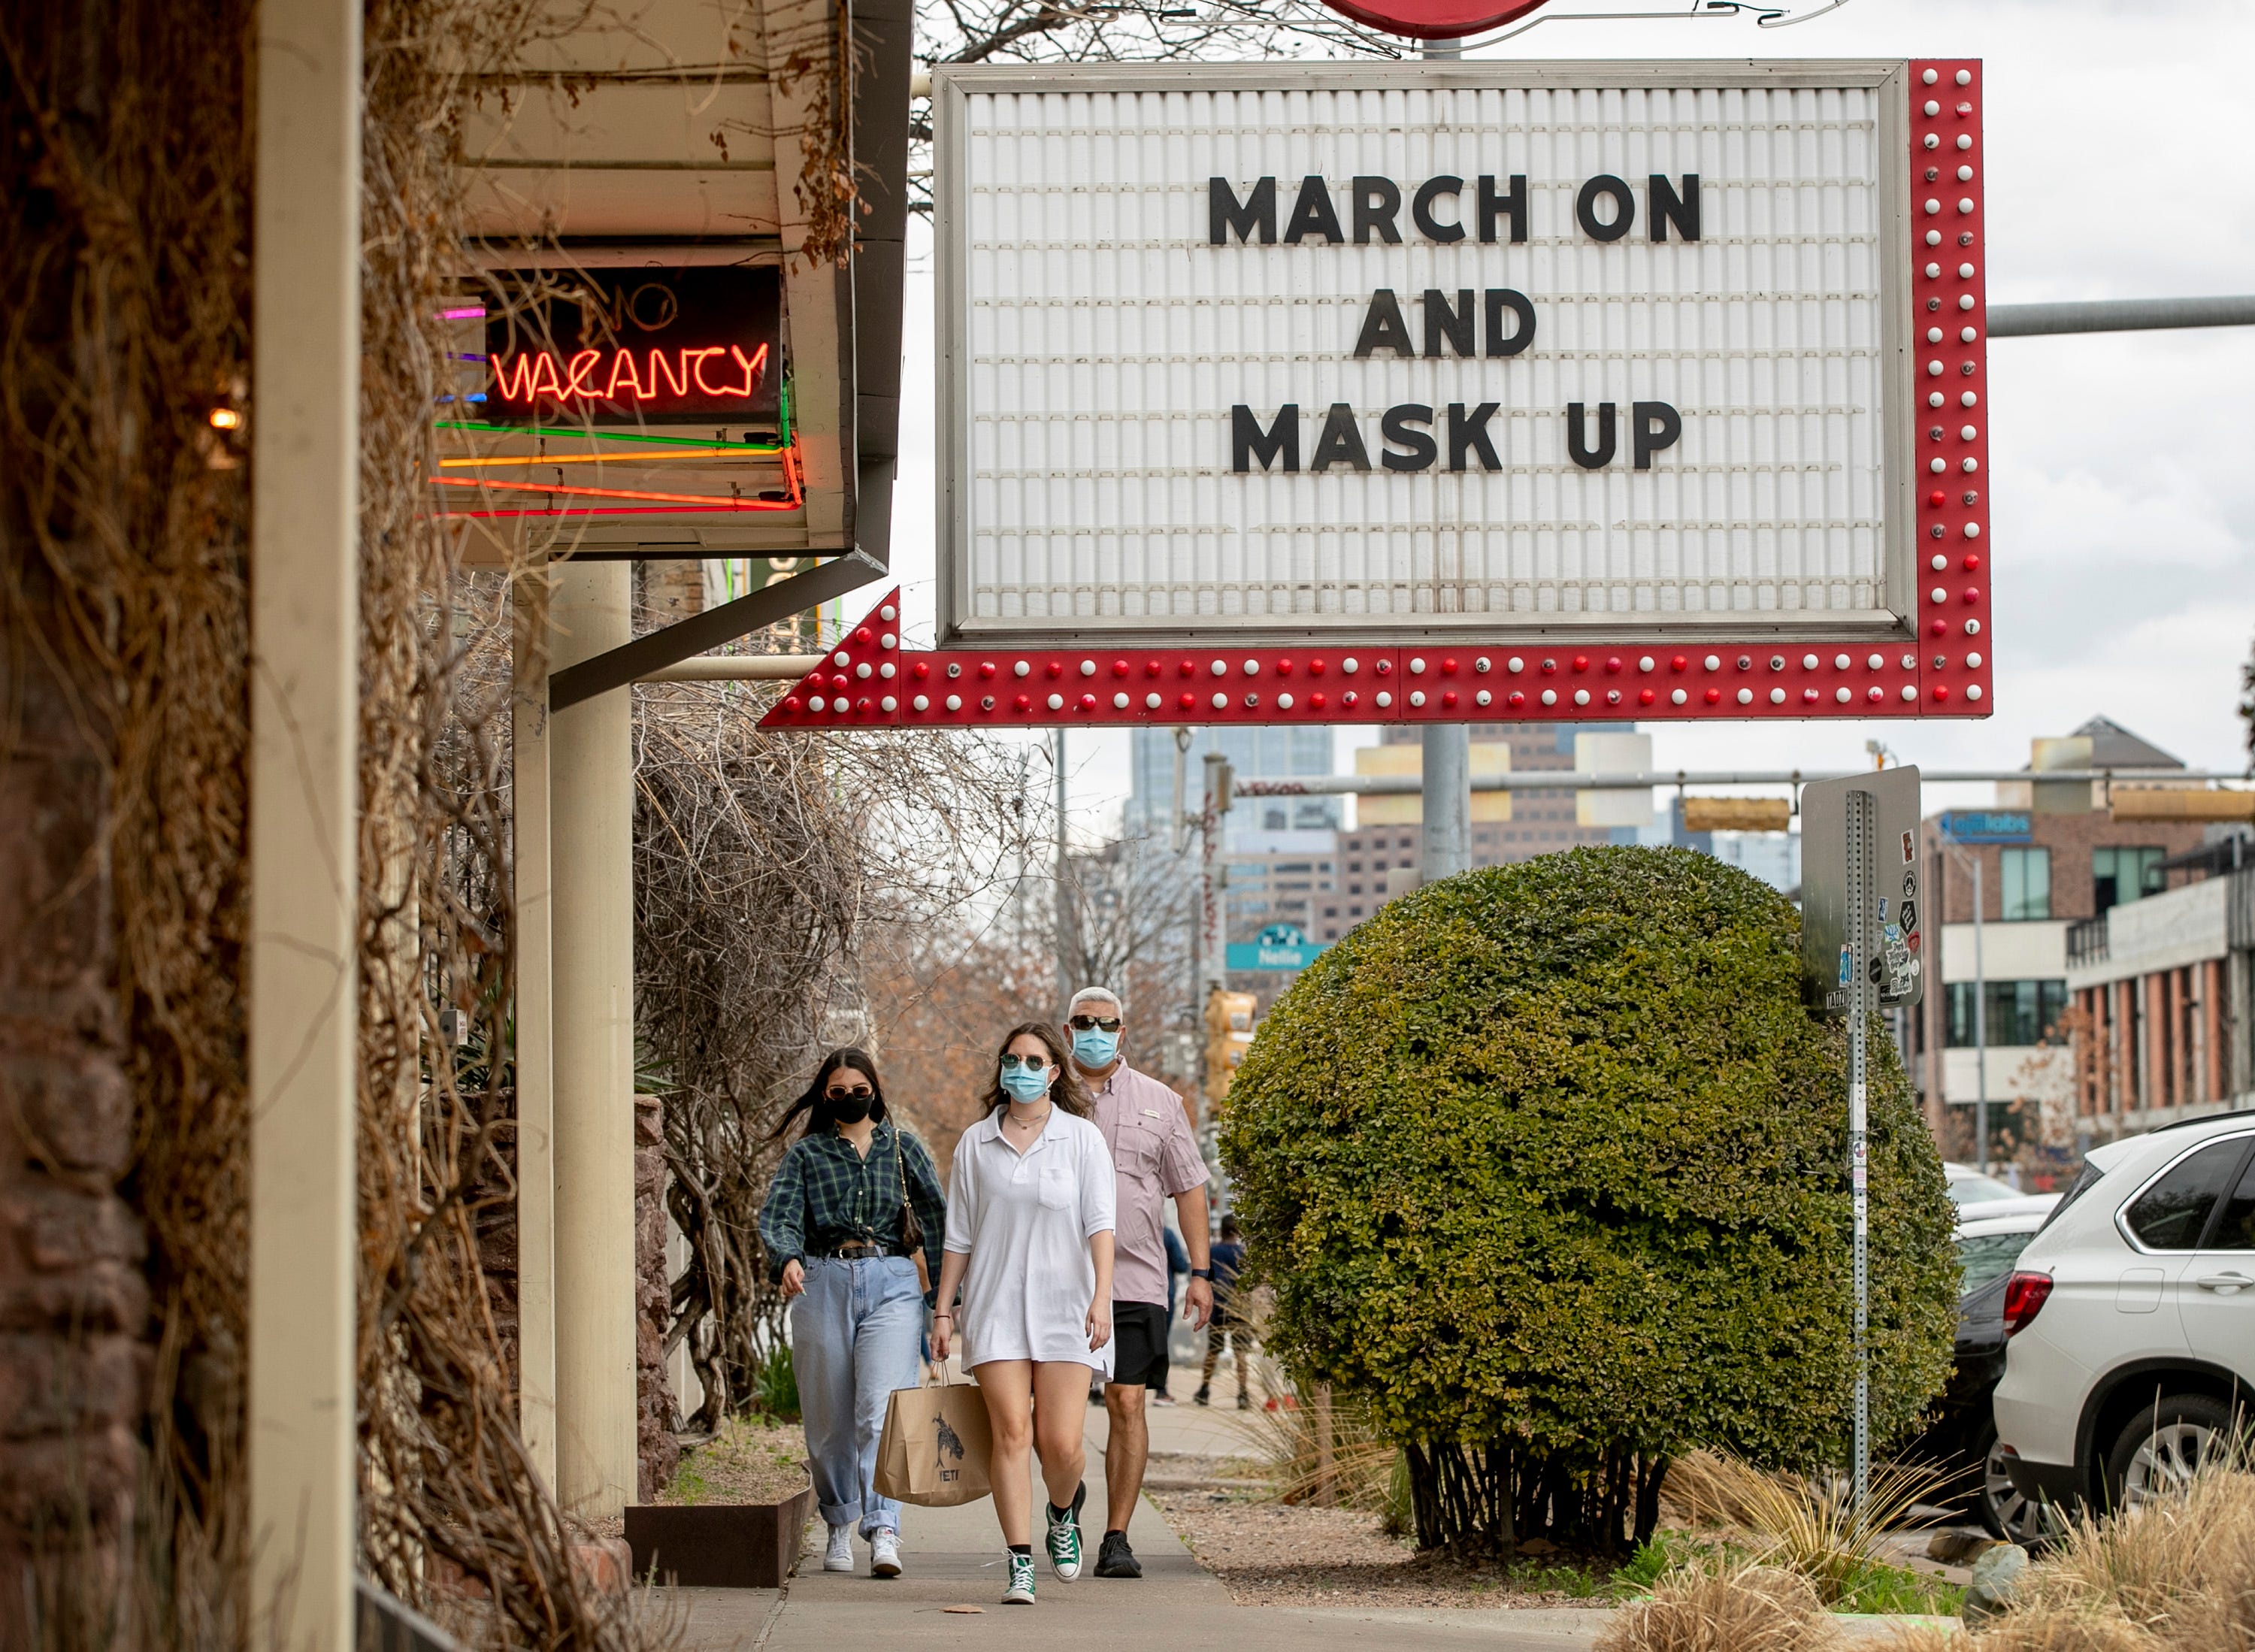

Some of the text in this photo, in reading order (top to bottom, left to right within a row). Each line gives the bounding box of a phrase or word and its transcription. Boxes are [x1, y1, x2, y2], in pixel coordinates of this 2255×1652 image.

[1209, 174, 1700, 245] MARCH ON
[1354, 289, 1536, 359] AND
[491, 342, 769, 402] VACANCY
[1231, 401, 1682, 472] MASK UP
[1258, 947, 1303, 967] Nellie
[939, 1469, 960, 1482] YETI
